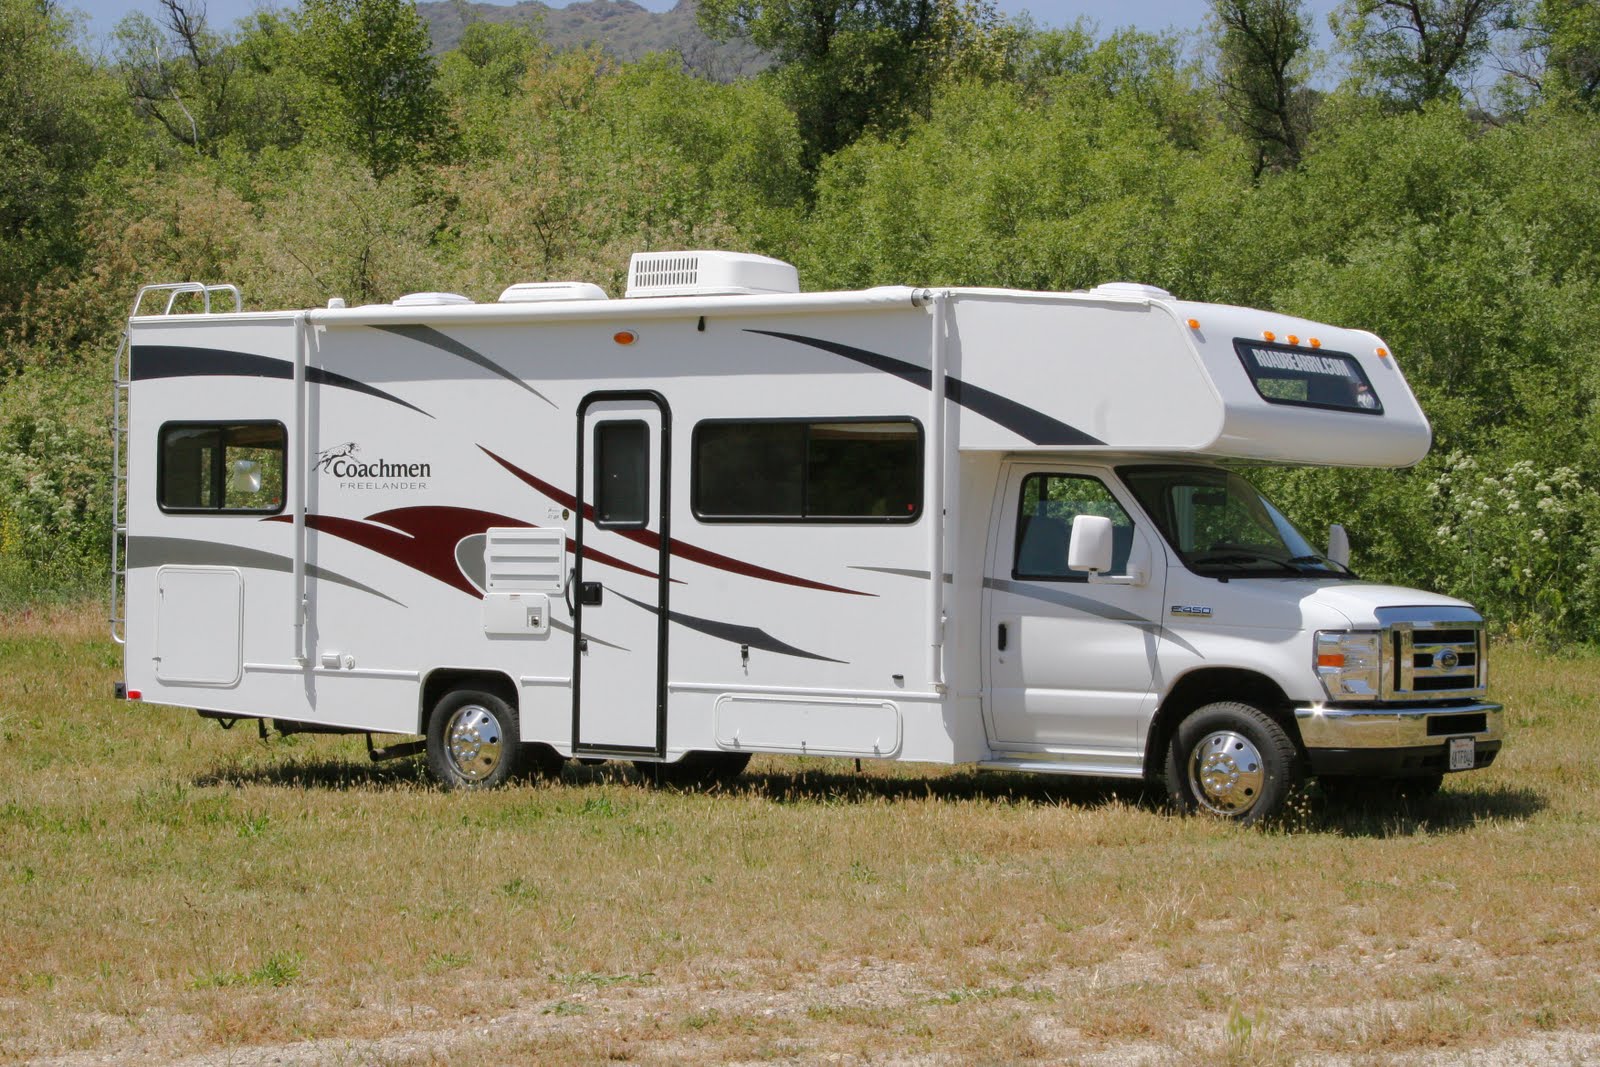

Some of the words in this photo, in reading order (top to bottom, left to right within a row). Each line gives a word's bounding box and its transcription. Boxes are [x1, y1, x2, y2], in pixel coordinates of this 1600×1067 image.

[1251, 348, 1351, 377] ROADBEARRV.COM
[333, 459, 431, 478] Coachmen
[340, 482, 427, 490] FREELANDER
